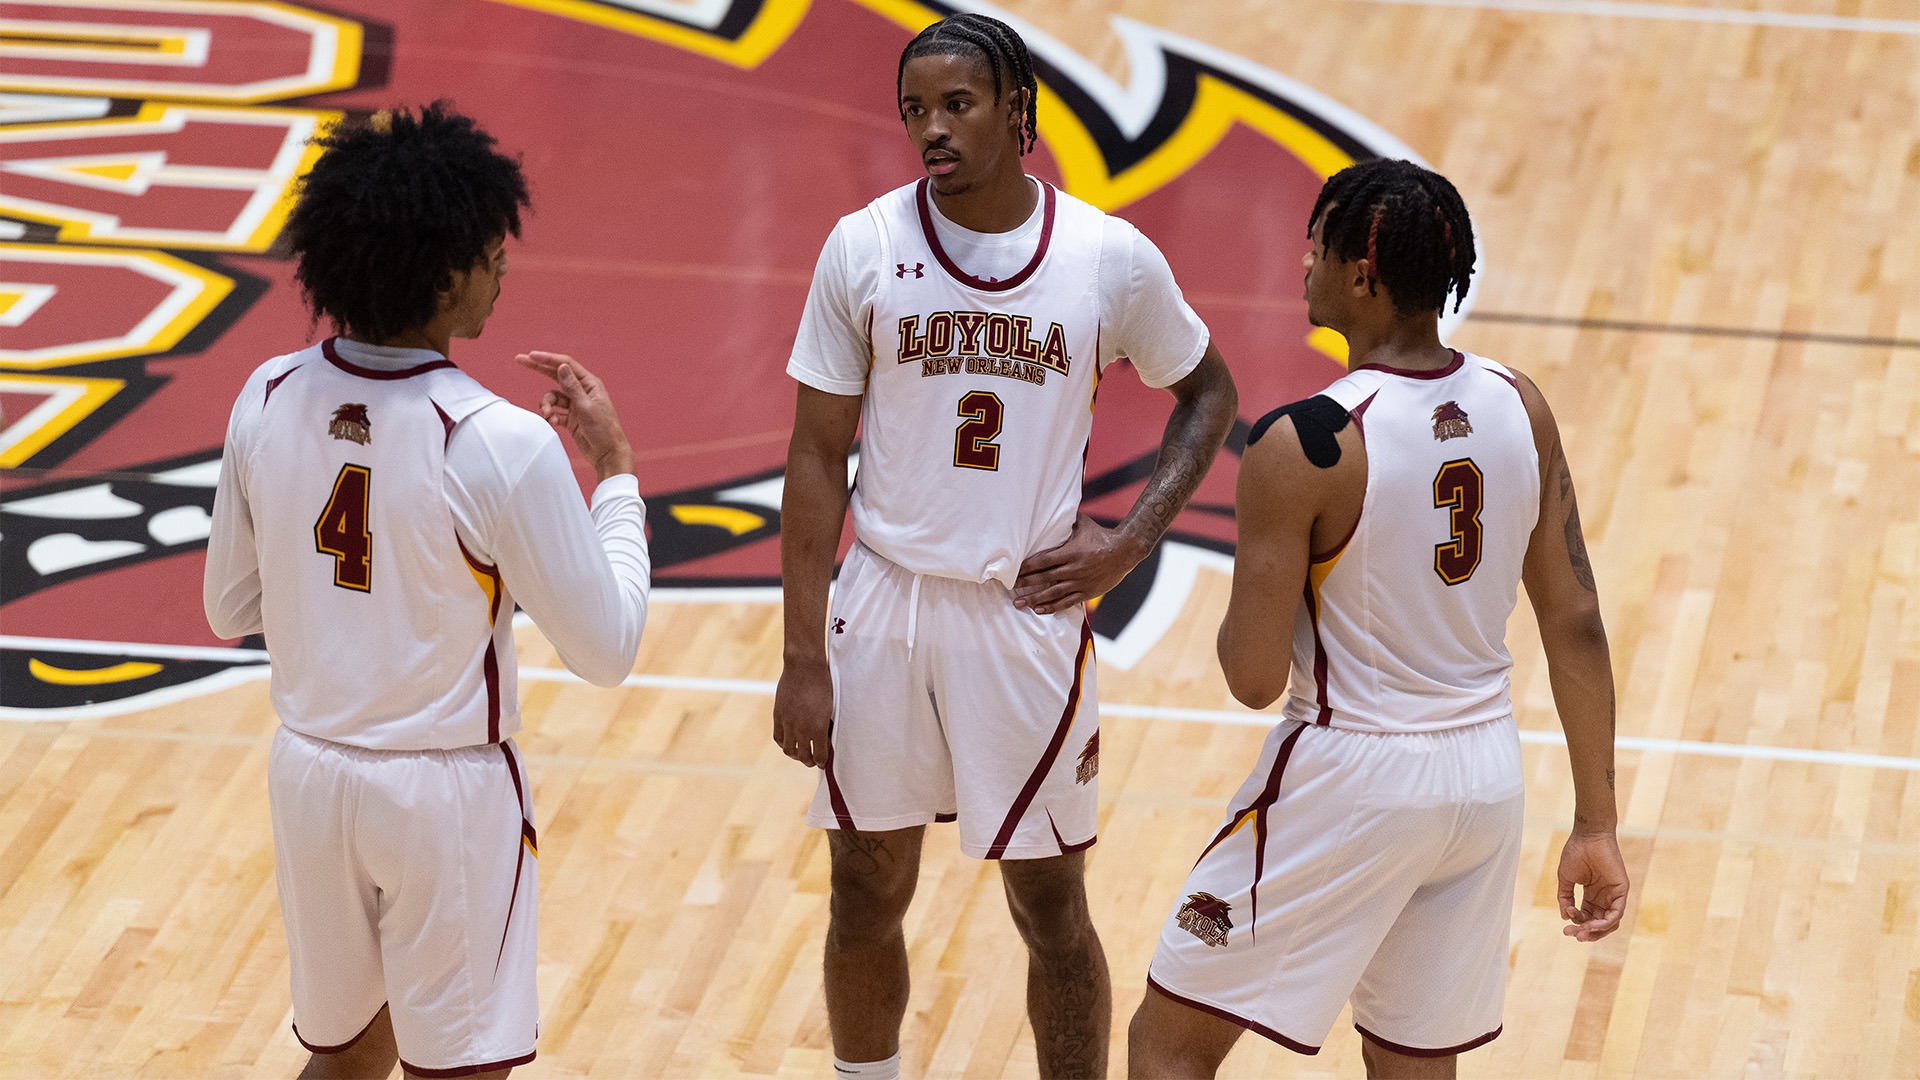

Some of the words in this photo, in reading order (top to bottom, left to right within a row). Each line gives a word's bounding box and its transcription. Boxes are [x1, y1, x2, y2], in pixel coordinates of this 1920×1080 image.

[898, 311, 1071, 376] LOYOLA
[922, 357, 964, 378] NEW
[965, 357, 1046, 386] ORLEANS
[953, 390, 1004, 471] 2
[314, 463, 372, 594] 4
[1433, 457, 1483, 586] 3
[1175, 903, 1228, 947] LOYOLA
